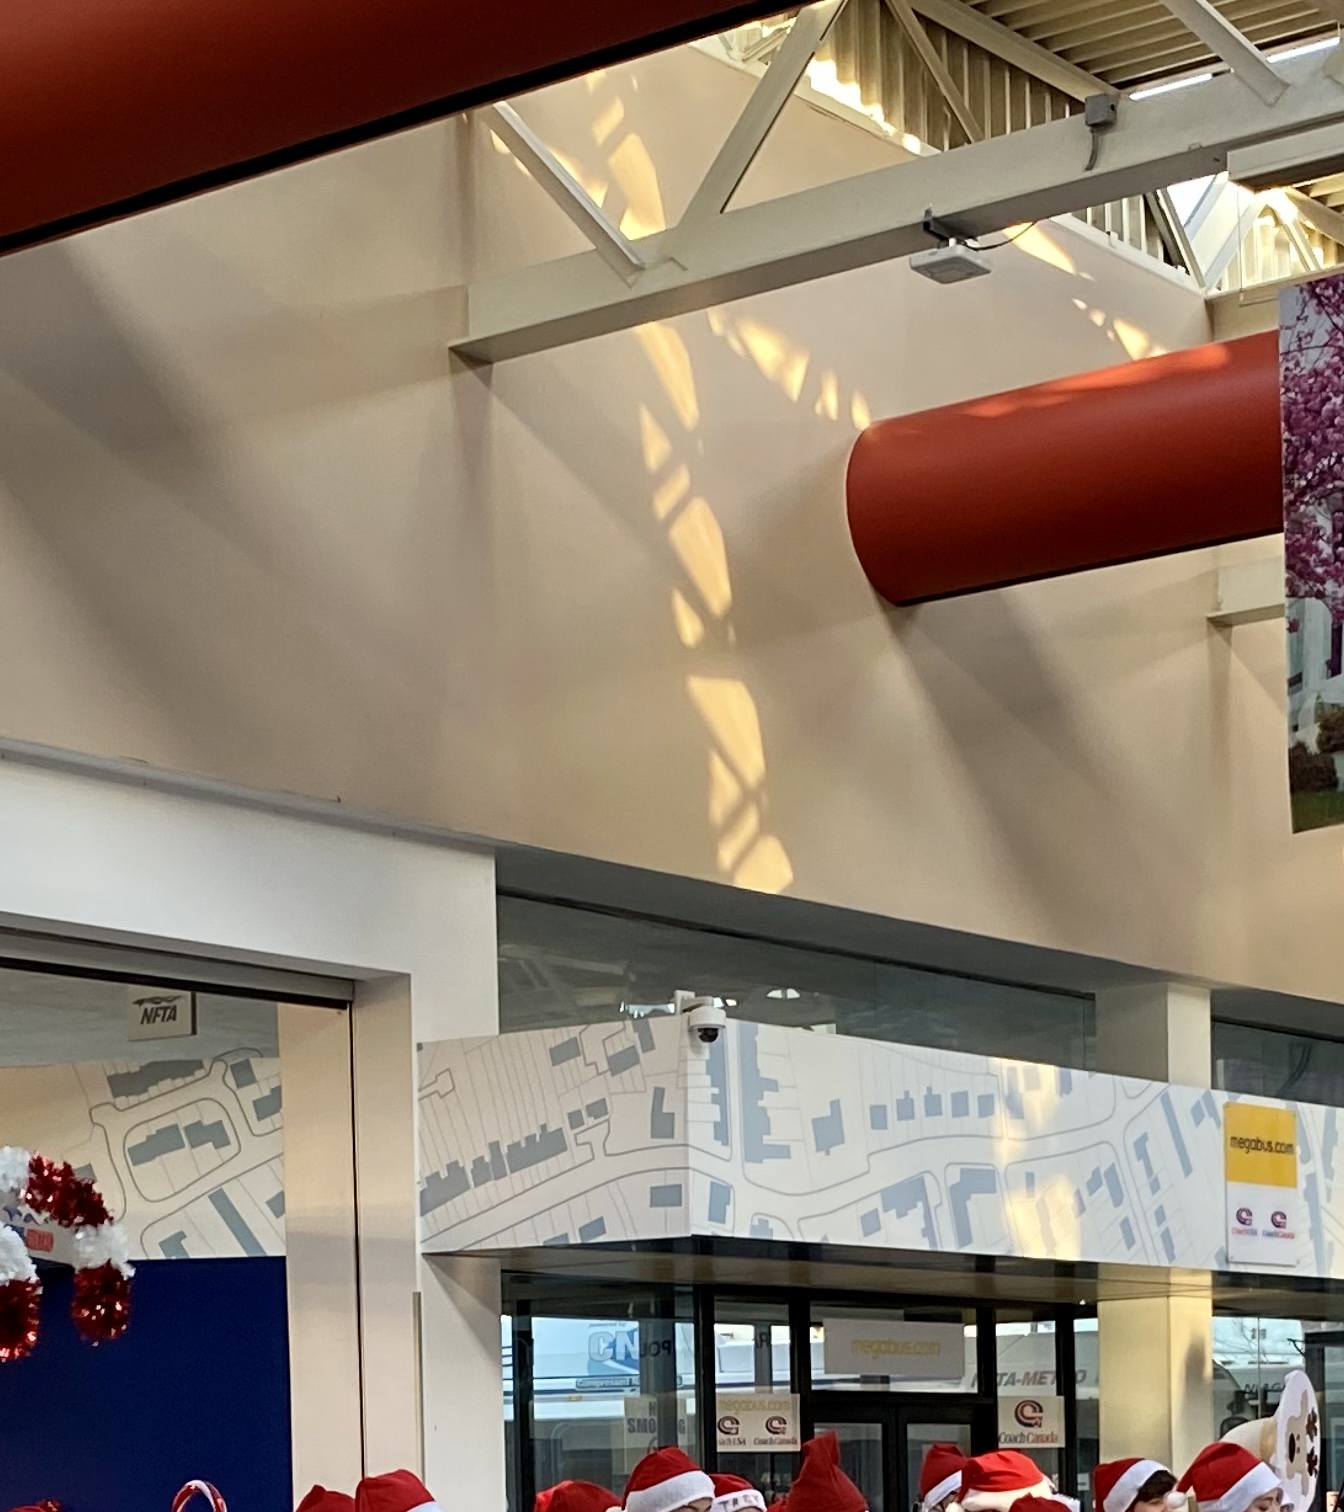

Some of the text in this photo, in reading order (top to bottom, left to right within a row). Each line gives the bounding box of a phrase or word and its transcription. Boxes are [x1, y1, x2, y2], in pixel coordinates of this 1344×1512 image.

[140, 1004, 177, 1025] NFTA
[1229, 1136, 1294, 1154] megabus.com
[851, 1338, 941, 1359] megabus.com
[1026, 1431, 1058, 1444] Canada
